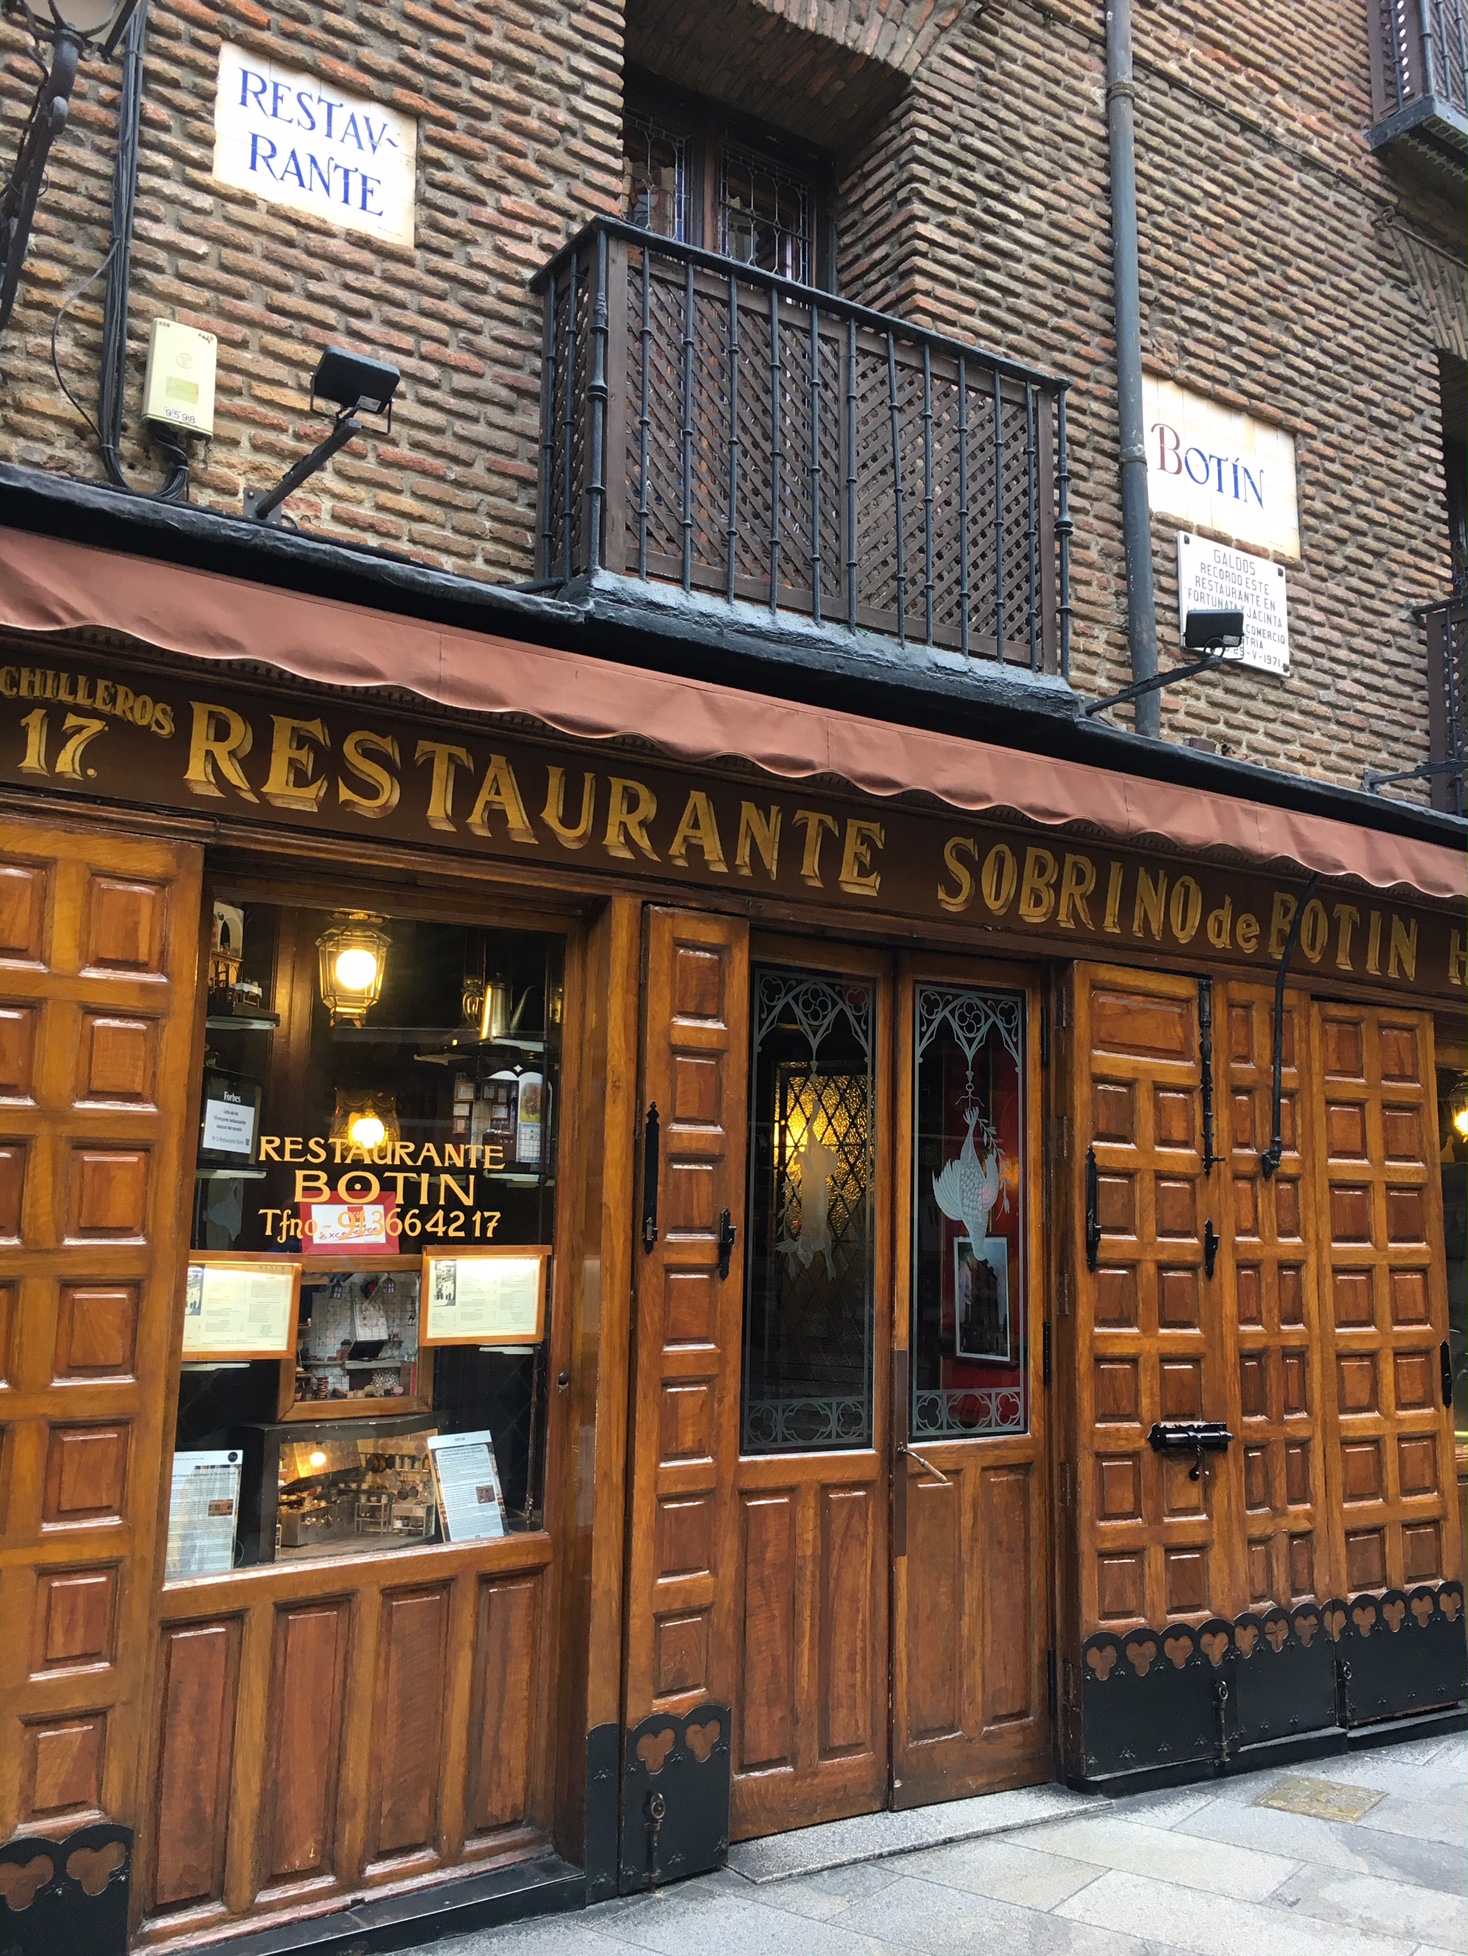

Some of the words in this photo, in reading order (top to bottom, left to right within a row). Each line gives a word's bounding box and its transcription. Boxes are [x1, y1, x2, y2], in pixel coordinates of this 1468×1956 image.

[248, 131, 384, 217] RANTE
[165, 408, 196, 424] 9598
[1195, 575, 1261, 607] RESTAURANTE
[1264, 598, 1276, 612] EN
[1245, 577, 1270, 596] ESTE
[1246, 605, 1283, 629] JACINTA
[1245, 623, 1286, 645] COMERCIO
[182, 700, 887, 897] RESTAURANTE
[937, 836, 1202, 944] SOBRINO
[1206, 895, 1260, 954] de
[1267, 891, 1419, 982] BOTIN
[223, 1091, 242, 1103] Forbes
[258, 1136, 506, 1170] RESTAURANTE
[294, 1169, 476, 1206] BOTIN
